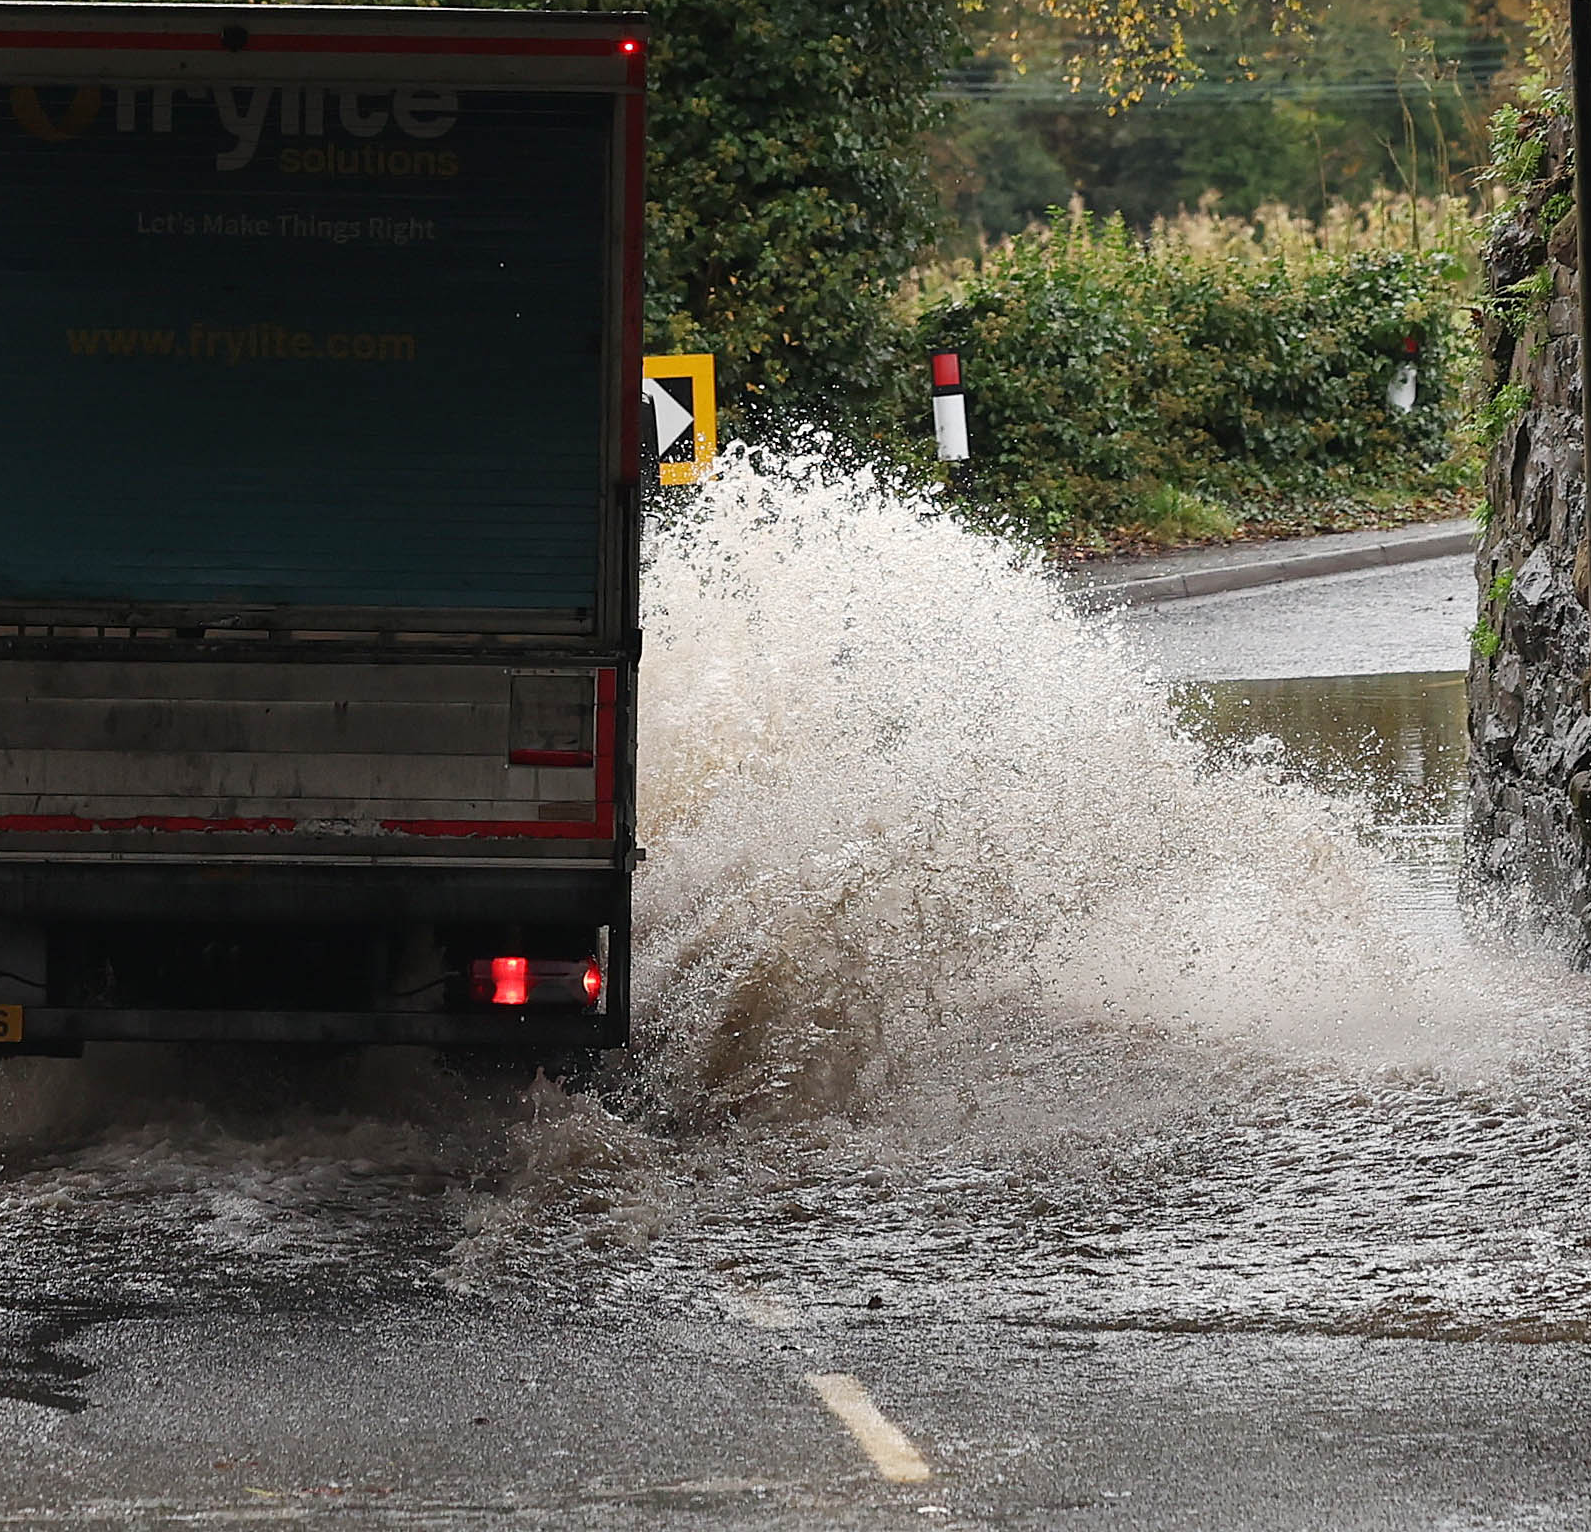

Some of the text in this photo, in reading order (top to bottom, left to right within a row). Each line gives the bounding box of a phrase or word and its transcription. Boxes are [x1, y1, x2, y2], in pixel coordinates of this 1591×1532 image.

[280, 144, 459, 177] solutions
[138, 212, 434, 244] Let's Make Things Right
[66, 321, 417, 368] www.frylite.com
